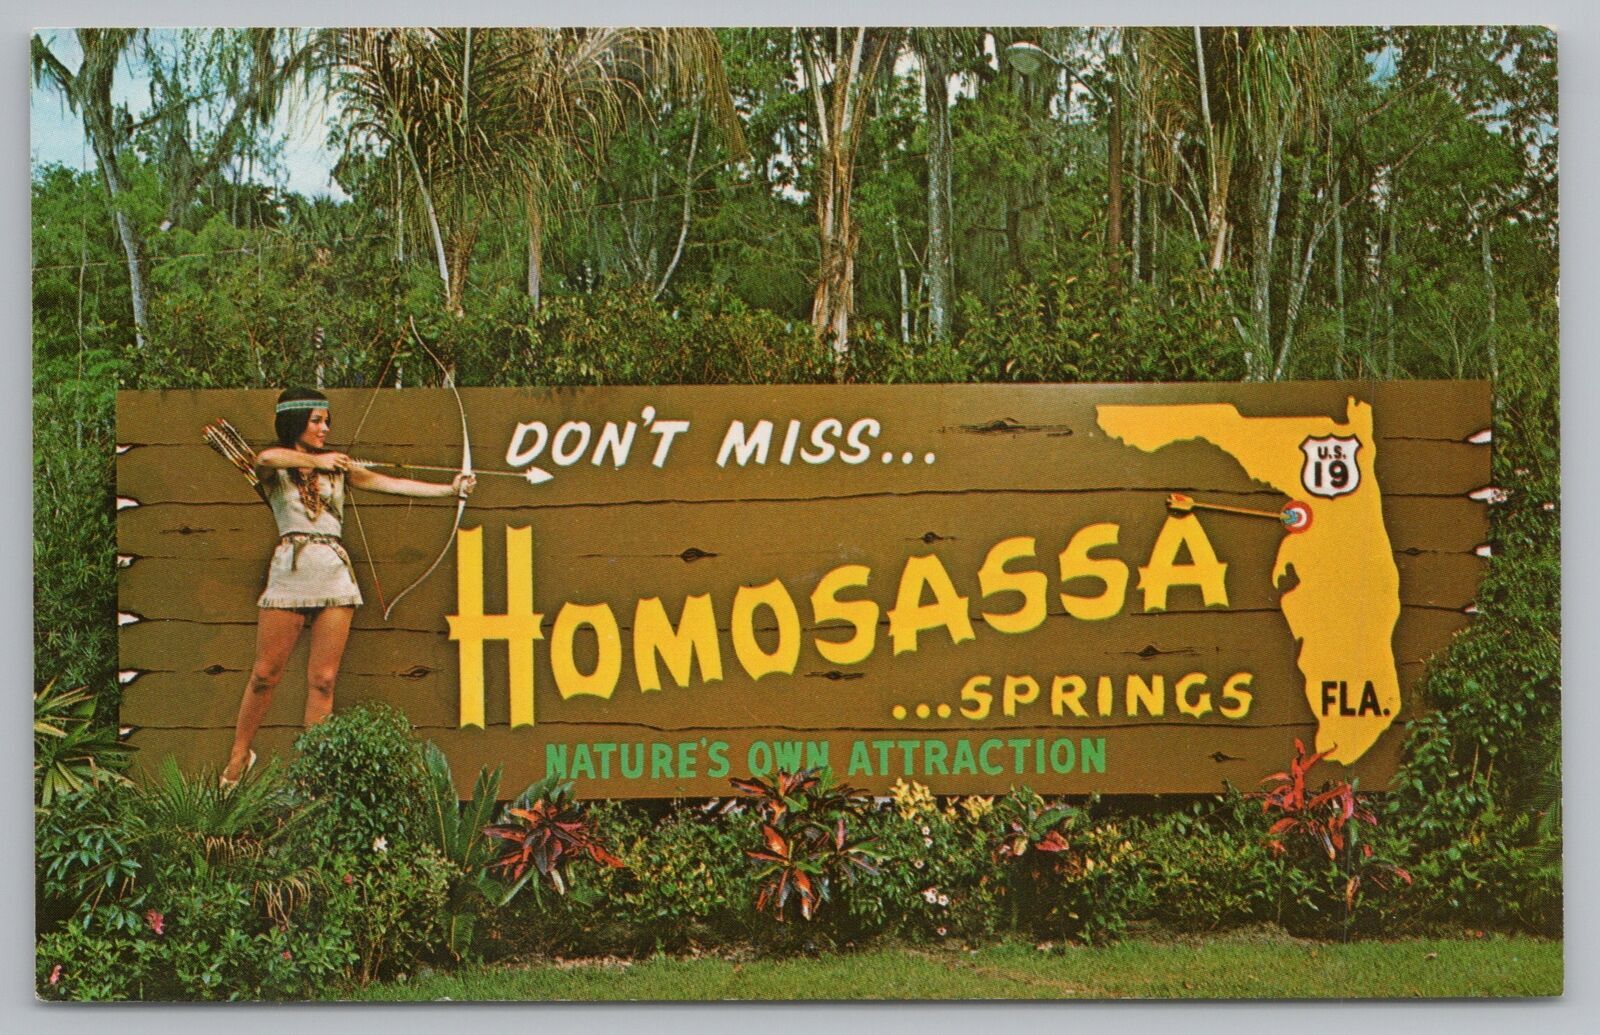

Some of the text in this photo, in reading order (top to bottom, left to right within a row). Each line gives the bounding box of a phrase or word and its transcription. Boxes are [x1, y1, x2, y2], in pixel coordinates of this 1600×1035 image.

[506, 406, 936, 468] DON'T MISS...
[1317, 445, 1347, 459] U.S.
[1314, 461, 1349, 488] 19
[445, 513, 1229, 730] HOMOSASSA
[1320, 681, 1391, 717] FLA.
[546, 738, 1106, 779] NATURE'S OWN ATTRACTION
